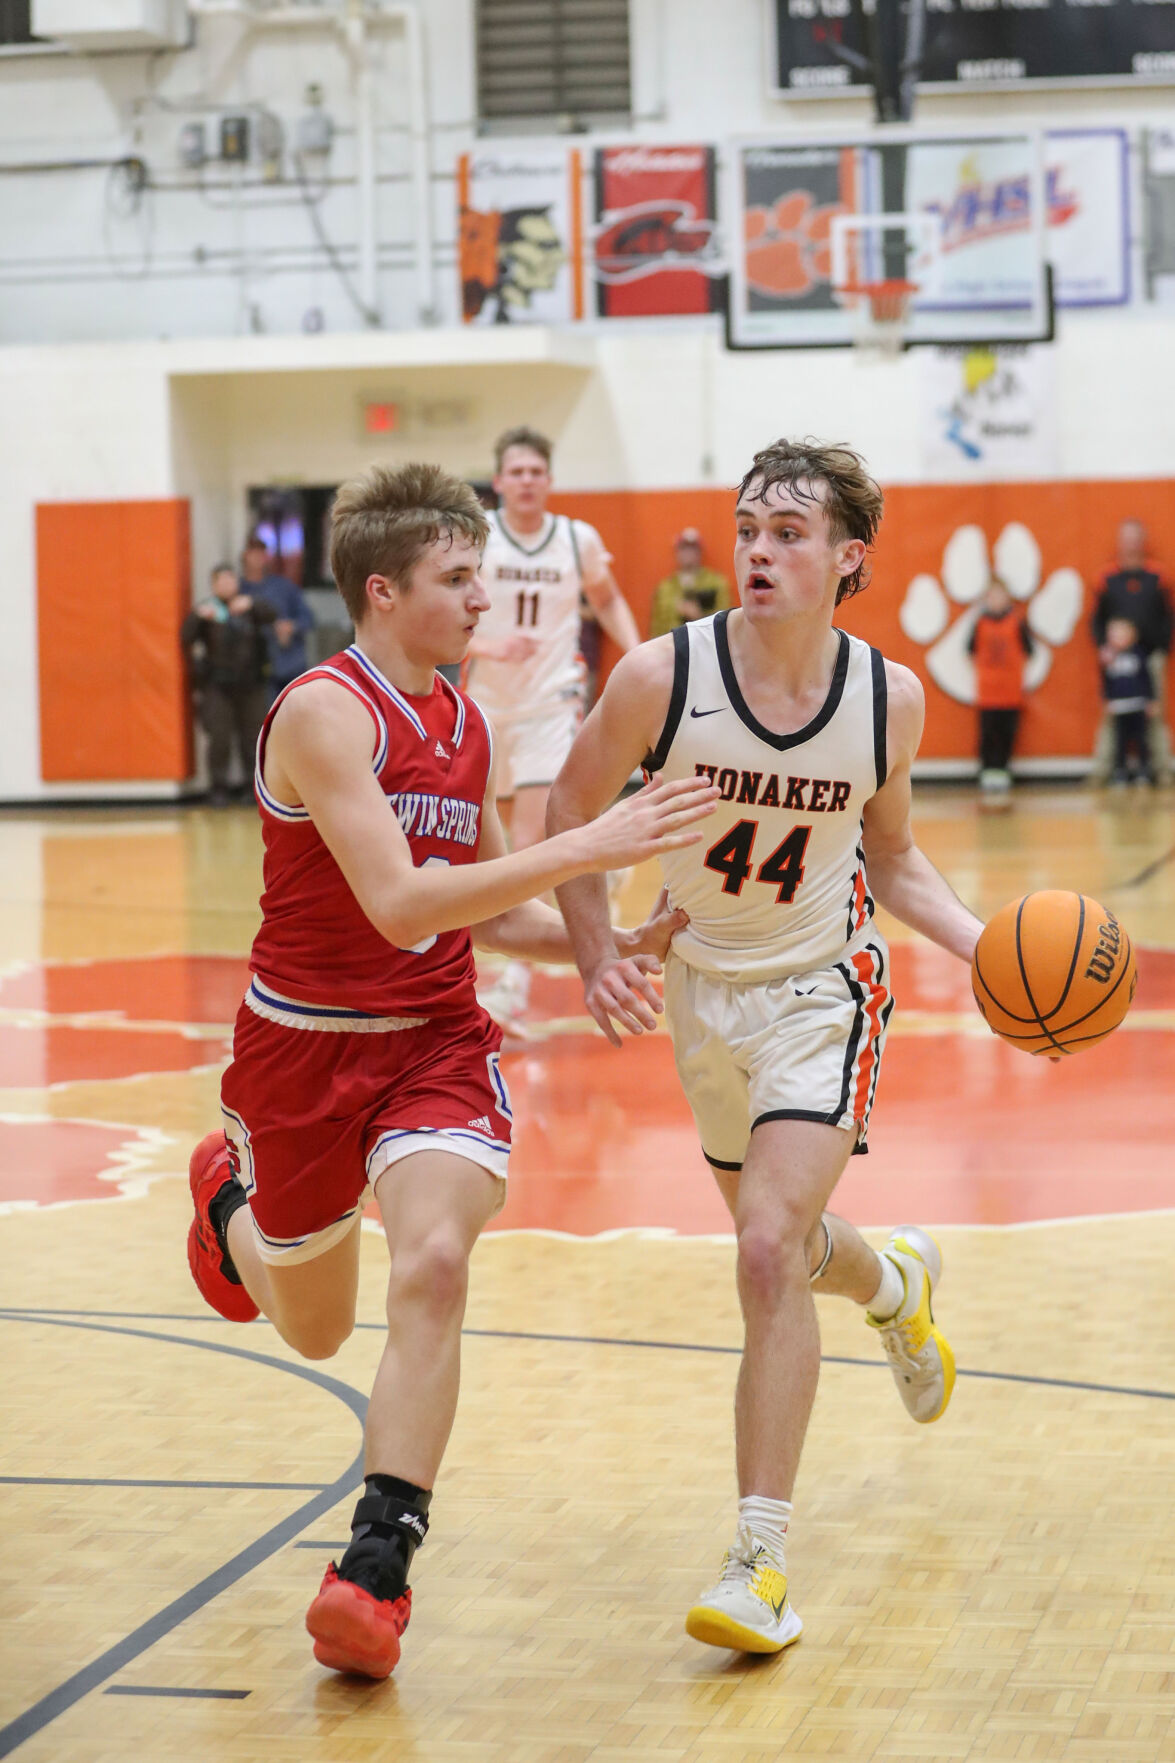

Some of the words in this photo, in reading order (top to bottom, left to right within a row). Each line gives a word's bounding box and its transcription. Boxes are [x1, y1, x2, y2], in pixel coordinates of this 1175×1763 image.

[515, 589, 540, 628] 11
[703, 818, 812, 904] 44
[1083, 906, 1120, 985] Wilso
